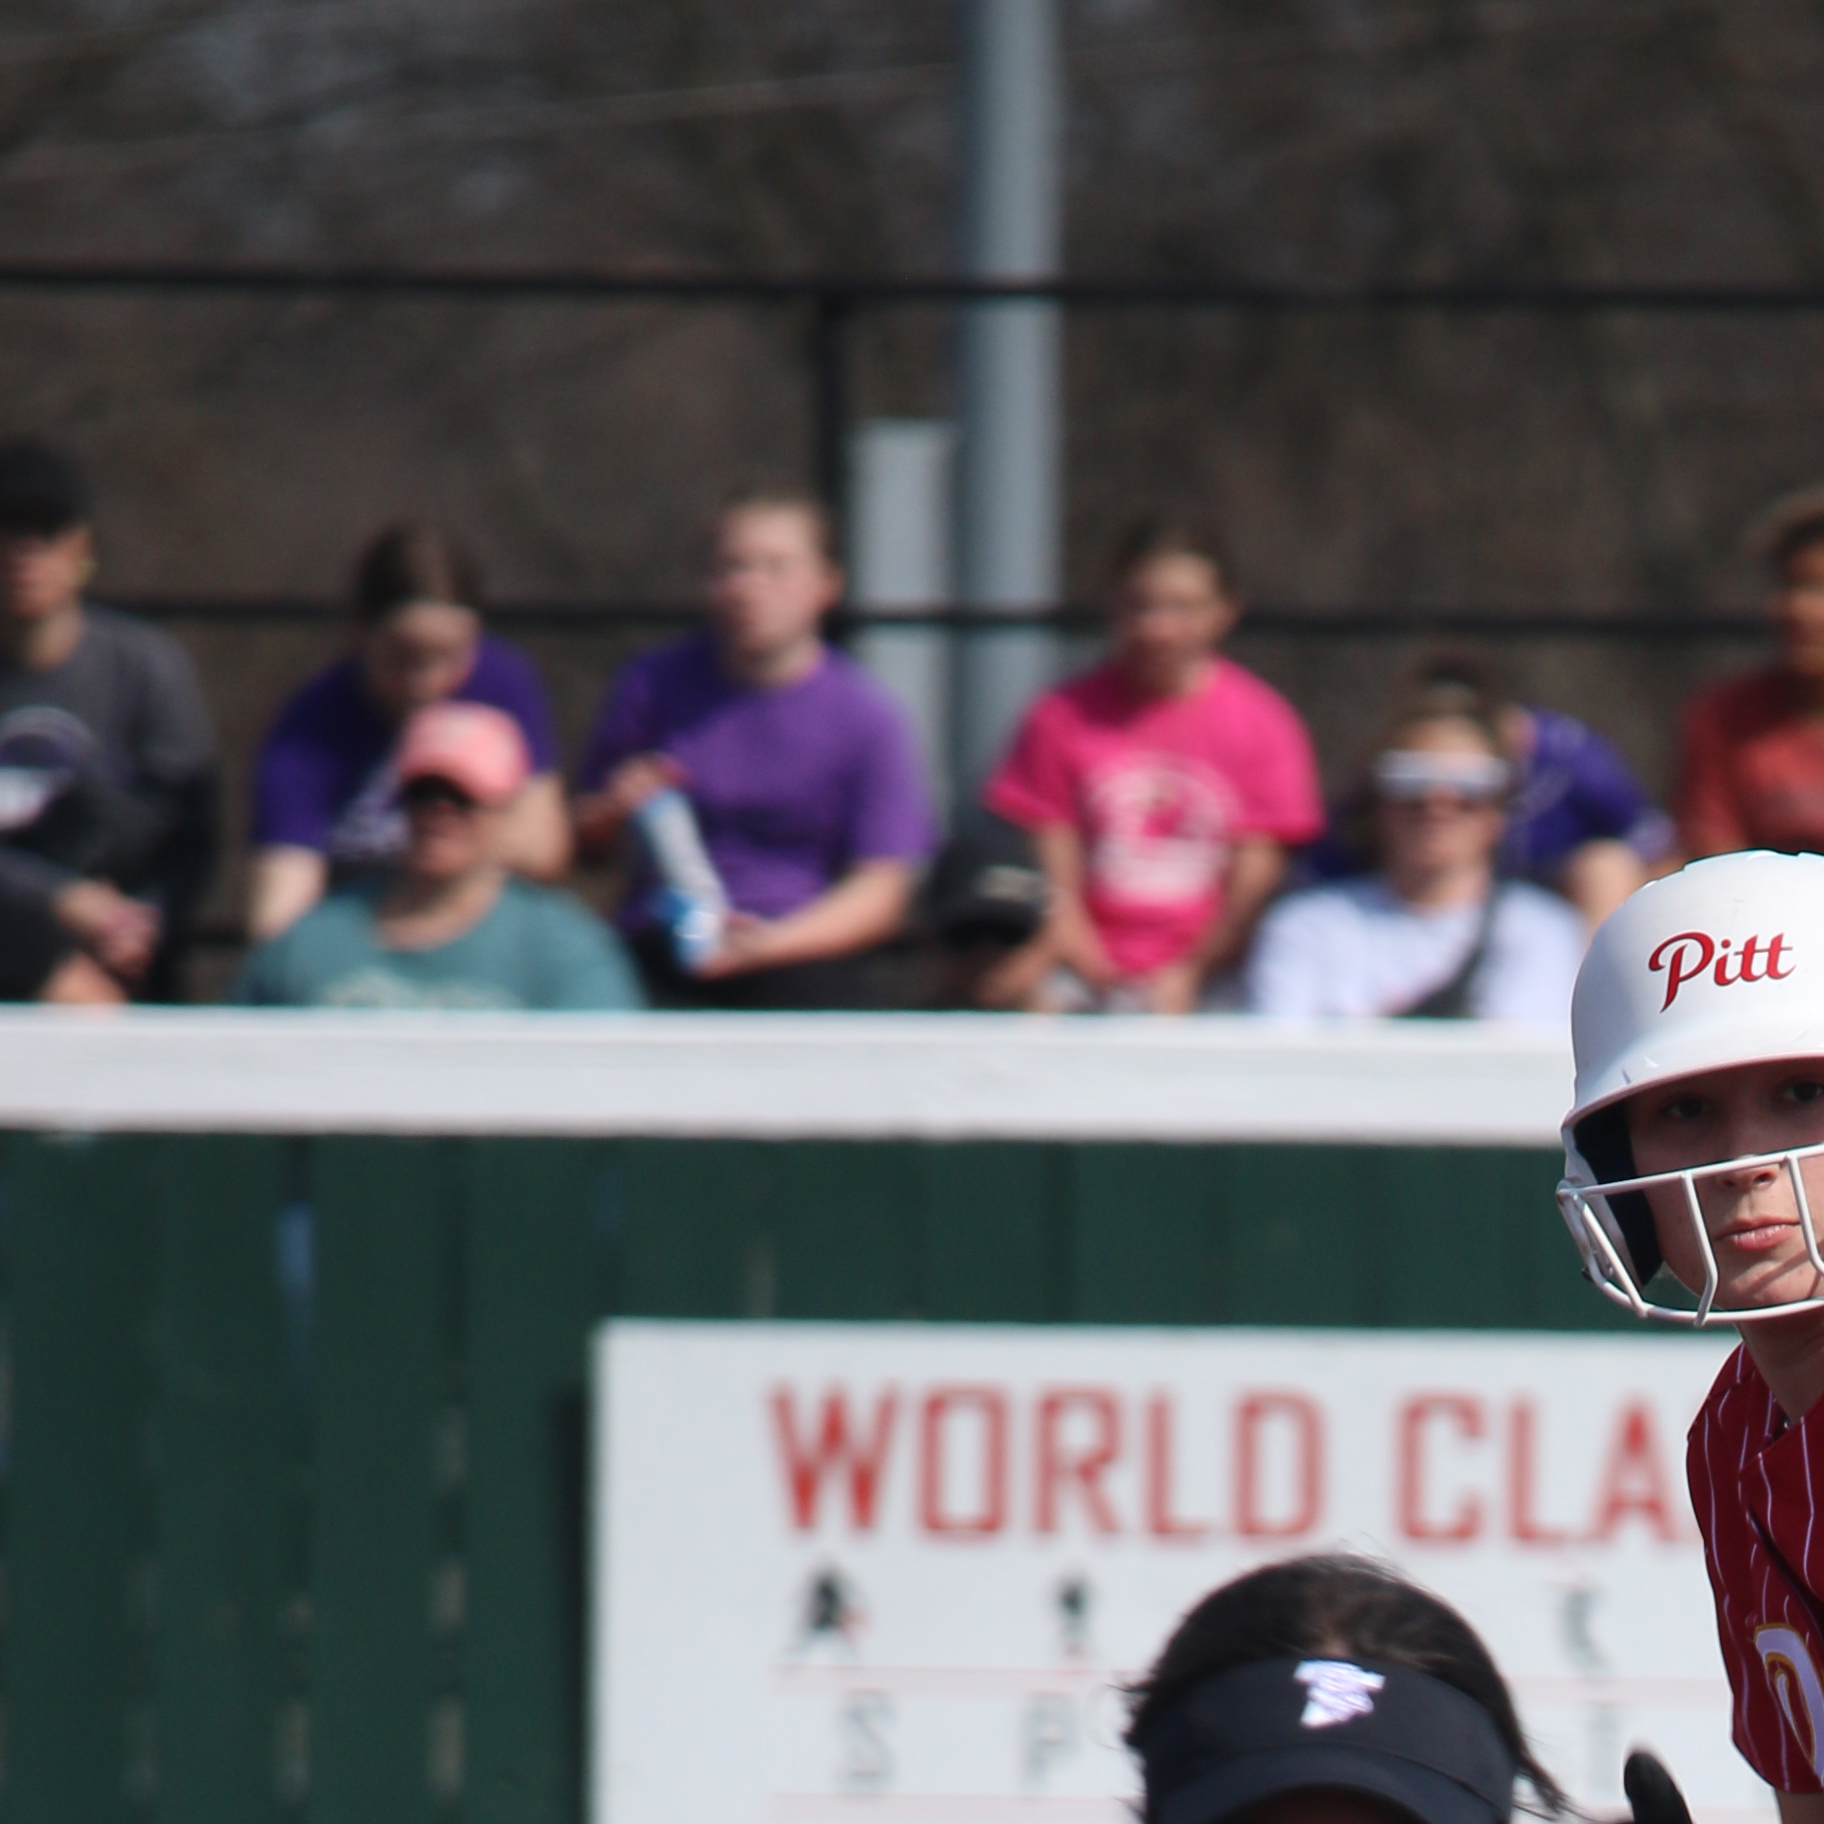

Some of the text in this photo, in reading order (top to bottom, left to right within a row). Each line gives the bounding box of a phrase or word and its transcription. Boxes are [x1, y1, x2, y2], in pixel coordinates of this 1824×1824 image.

[1647, 930, 1797, 1015] Pitt
[766, 1380, 1696, 1550] WORLD CLA
